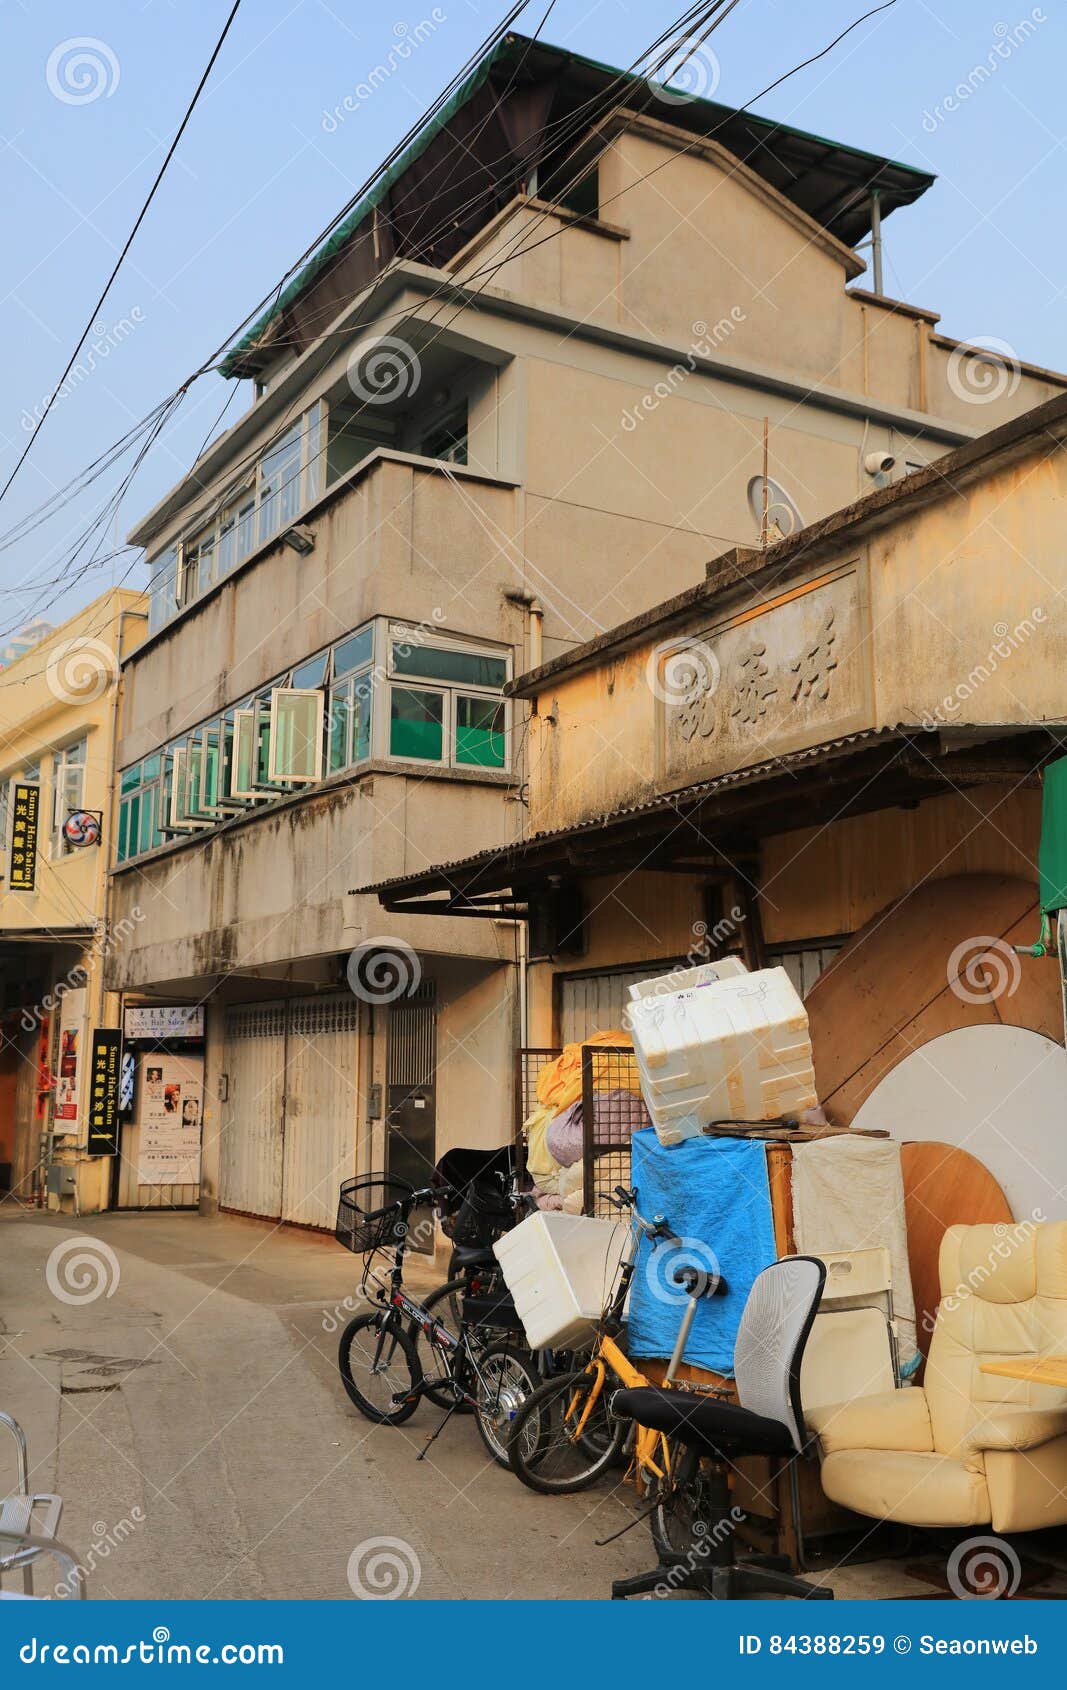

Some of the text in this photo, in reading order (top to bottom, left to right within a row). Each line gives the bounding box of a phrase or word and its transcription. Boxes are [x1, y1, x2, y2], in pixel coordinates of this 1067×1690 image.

[25, 790, 38, 880] Sunny Hair Salon
[106, 1046, 117, 1125] Sunny Hair Salon
